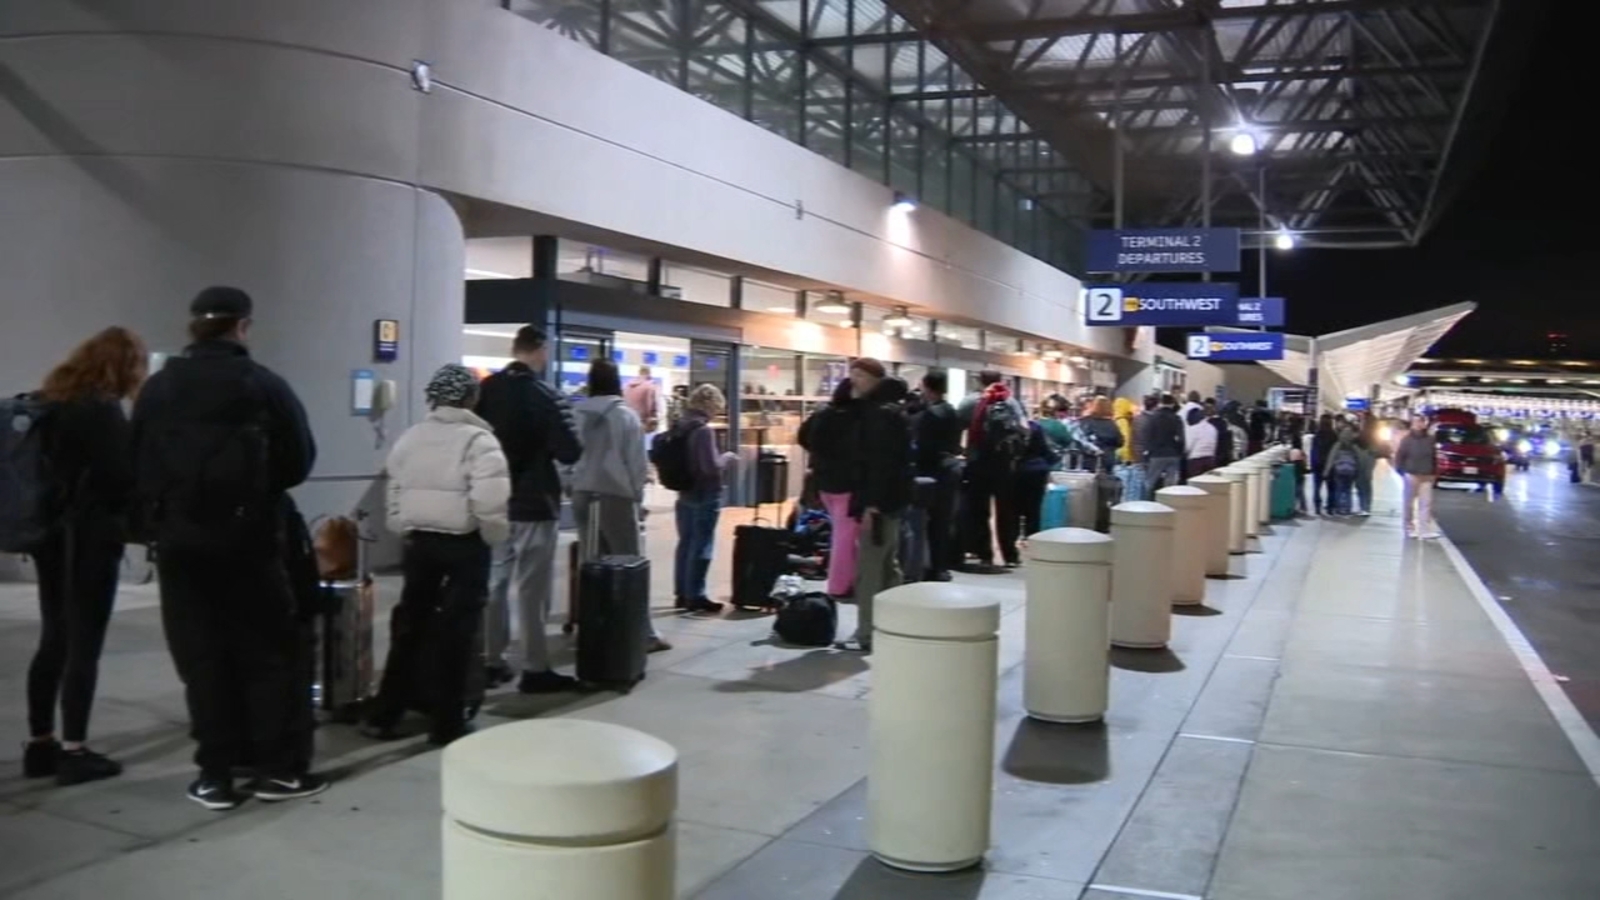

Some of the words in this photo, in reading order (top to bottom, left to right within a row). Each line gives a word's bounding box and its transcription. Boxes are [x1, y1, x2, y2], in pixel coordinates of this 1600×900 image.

[1120, 236, 1190, 248] TERMINAL
[1192, 235, 1201, 247] 2
[1117, 252, 1206, 265] DEPARTURES
[1096, 293, 1114, 317] 2
[1139, 298, 1221, 310] SOUTHWEST
[1193, 339, 1204, 354] 2
